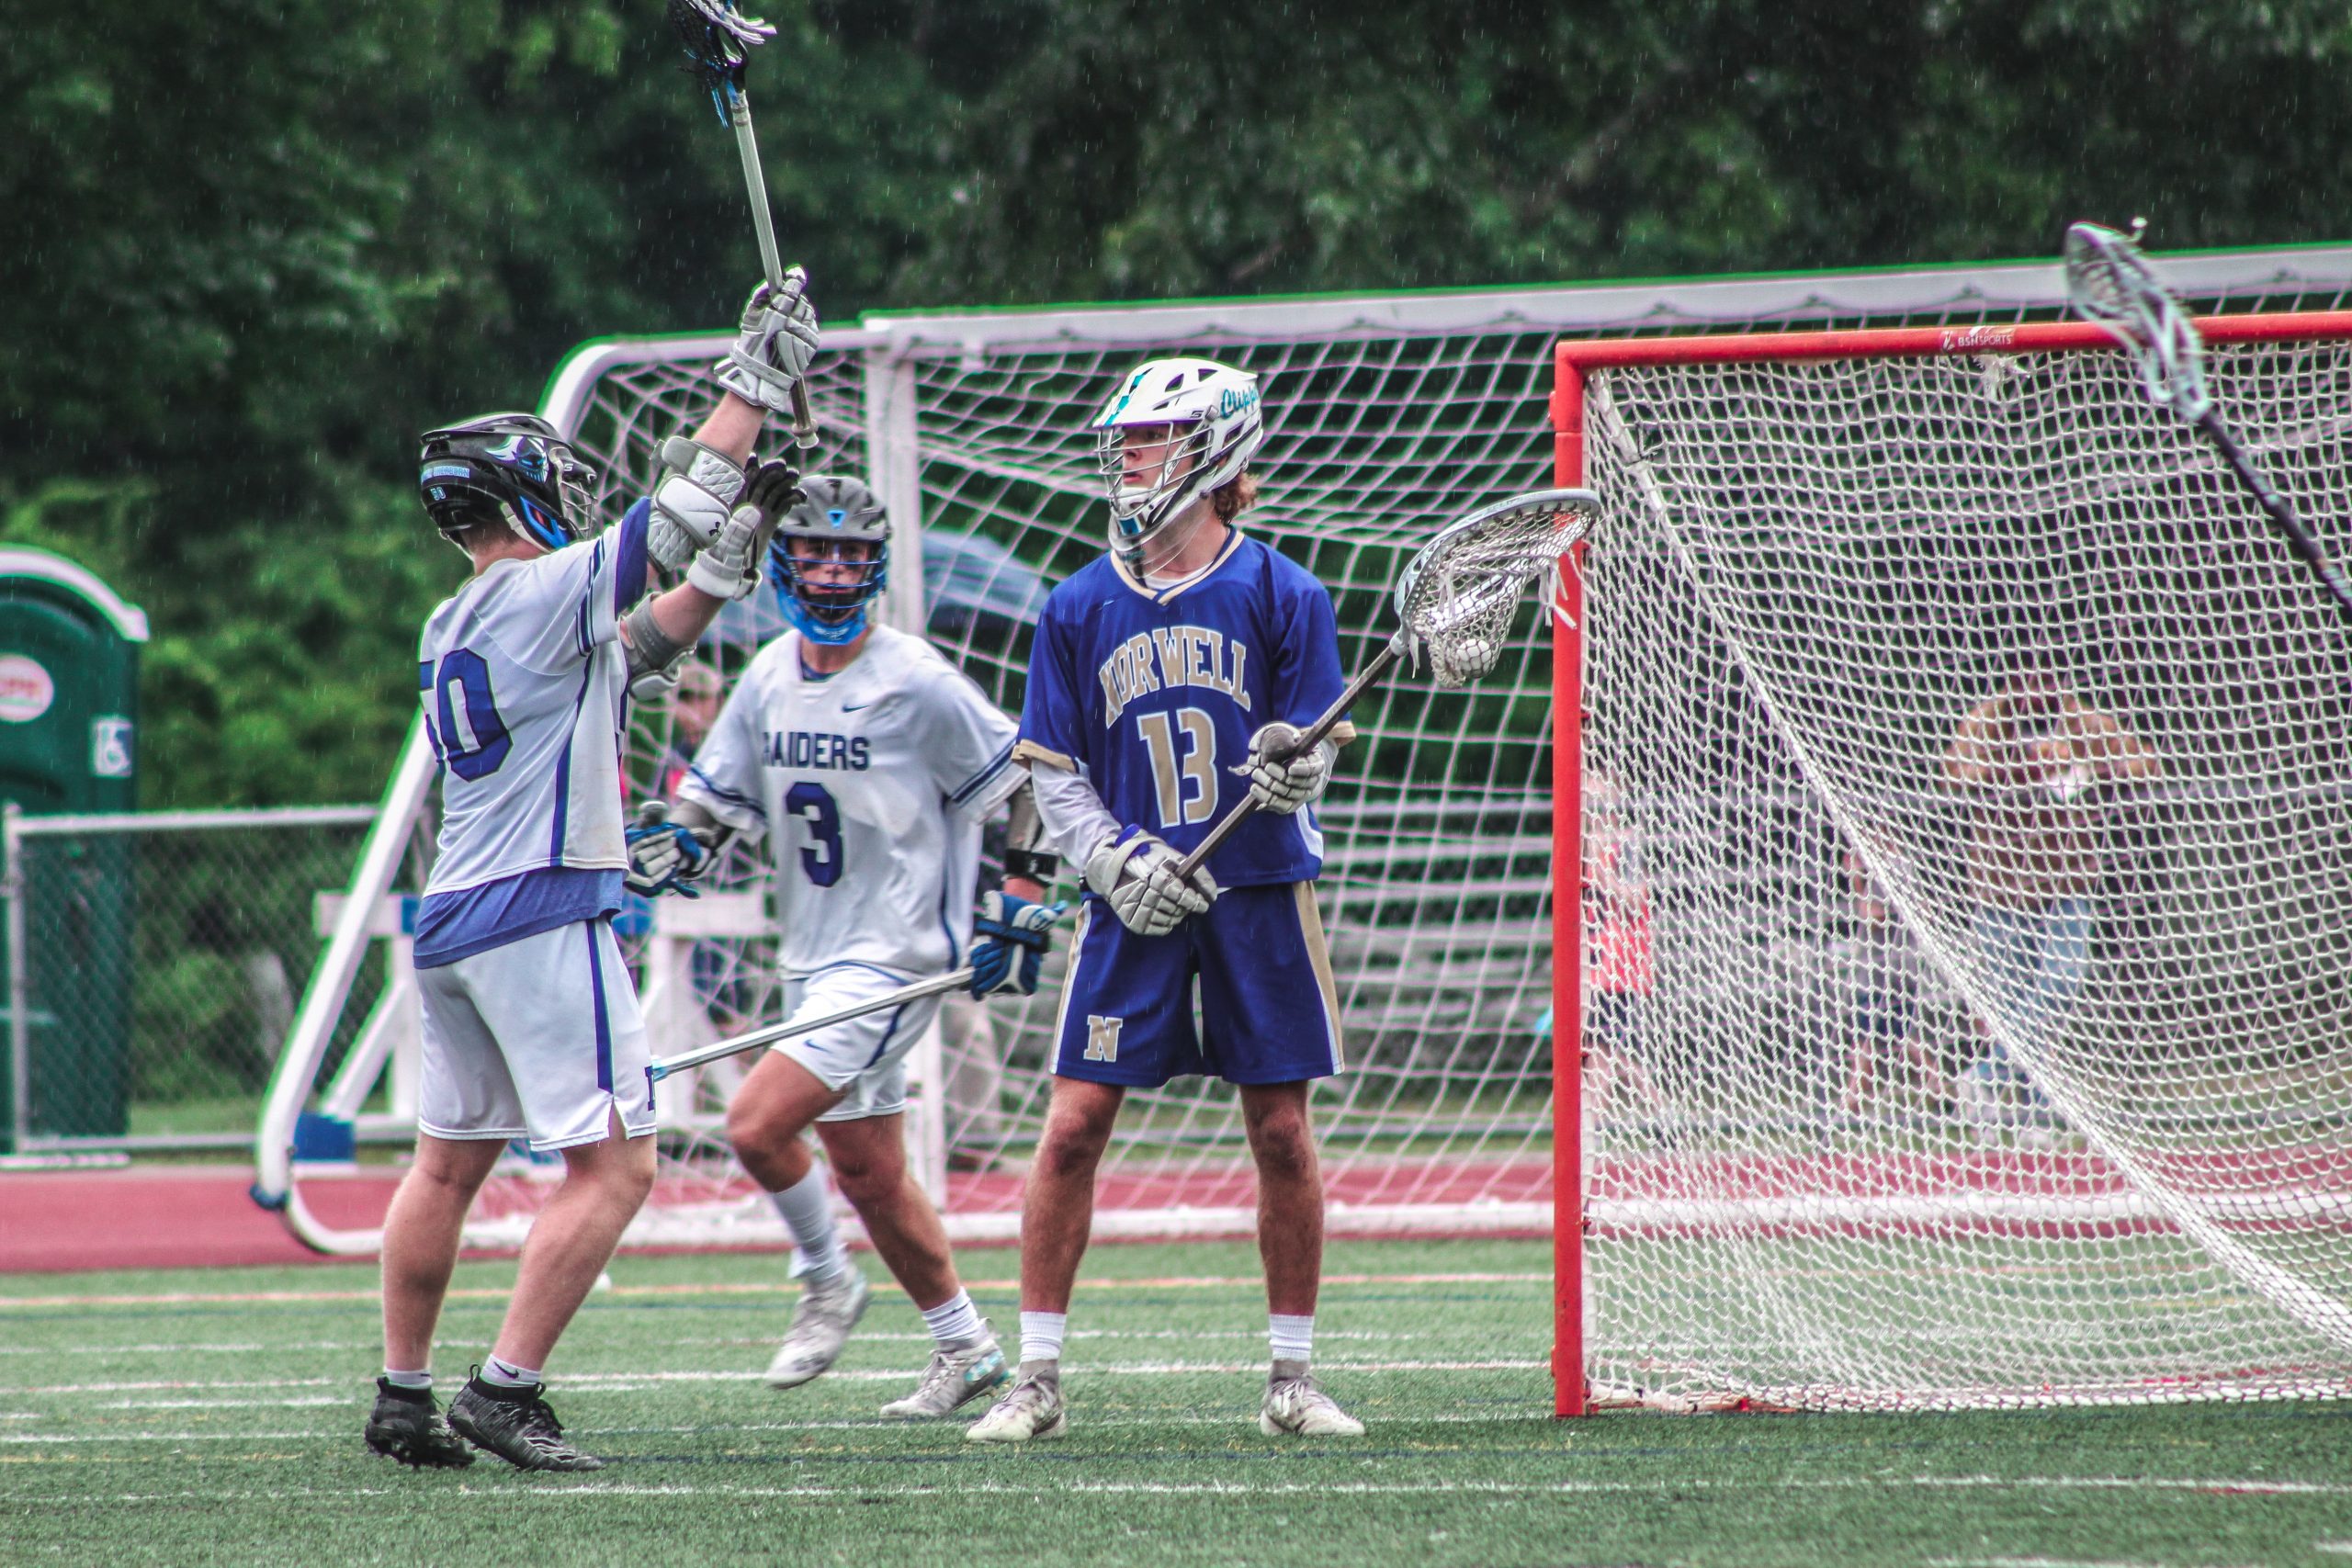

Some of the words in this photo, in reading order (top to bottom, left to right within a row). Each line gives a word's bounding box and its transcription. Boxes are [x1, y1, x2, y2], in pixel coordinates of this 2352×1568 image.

[430, 486, 447, 501] 50
[1099, 625, 1251, 730] NORWELL
[1136, 706, 1219, 829] 13
[786, 781, 844, 888] 3
[1082, 1013, 1124, 1063] N
